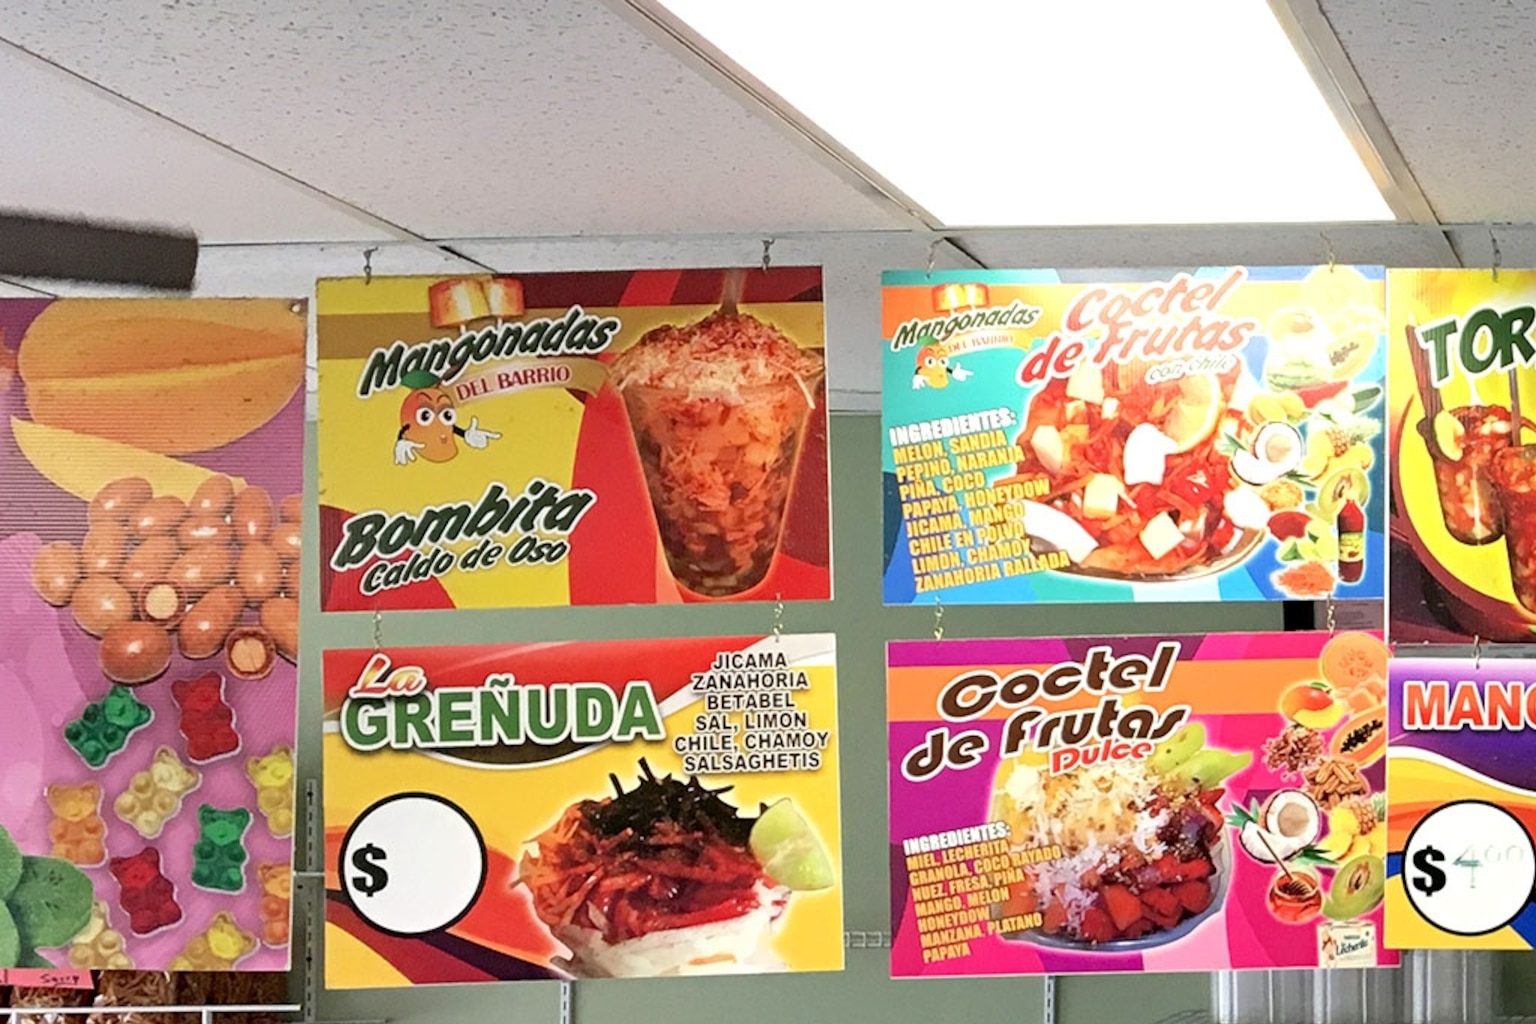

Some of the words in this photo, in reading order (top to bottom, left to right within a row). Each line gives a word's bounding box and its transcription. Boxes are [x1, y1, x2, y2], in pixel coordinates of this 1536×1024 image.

[1066, 269, 1243, 332] Coctel
[892, 302, 1040, 350] Mangonadas
[358, 306, 621, 397] Mangonadas
[1021, 336, 1085, 383] de
[456, 377, 492, 400] DEL
[497, 366, 570, 390] BARRIO
[1148, 363, 1184, 381] con
[889, 408, 1018, 446] INGREDIENTES:
[949, 430, 1007, 454] SANDIA
[956, 445, 1026, 471] NARANJA
[942, 471, 985, 492] COCO
[964, 479, 1050, 507] HONEYDOW
[335, 480, 593, 568] Bombita
[969, 502, 1025, 526] MANGO
[909, 534, 952, 556] CHILE
[955, 531, 974, 547] EN
[363, 547, 459, 592] Caldo
[461, 540, 500, 569] de
[510, 538, 569, 564] Oso
[915, 563, 1001, 593] ZANAHORIA
[1004, 551, 1070, 577] RALLADA
[713, 652, 787, 669] JICAMA
[355, 654, 427, 696] La
[692, 672, 808, 690] ZANAHORIA
[942, 645, 1178, 718] Coctel
[345, 676, 661, 748] GREÑUDA
[707, 693, 795, 710] BETABEL
[696, 715, 738, 732] SAL,
[745, 712, 807, 729] LIMON
[675, 735, 738, 753] CHILE,
[745, 732, 828, 749] CHAMOY
[905, 730, 985, 779] de
[685, 752, 820, 772] SALSAGHETIS
[1052, 740, 1152, 774] Dulce
[903, 821, 1012, 856] INGREDIENTES:
[942, 839, 1010, 862] LECHERITA
[351, 843, 389, 896] $
[974, 855, 1010, 873] COCO
[1011, 845, 1062, 867] RAYADO
[994, 867, 1025, 885] PIÑA
[968, 887, 1010, 907] MELON
[918, 906, 990, 933] HONEYDOW
[988, 912, 1043, 934] PLATANO
[923, 942, 971, 964] PAPAYA
